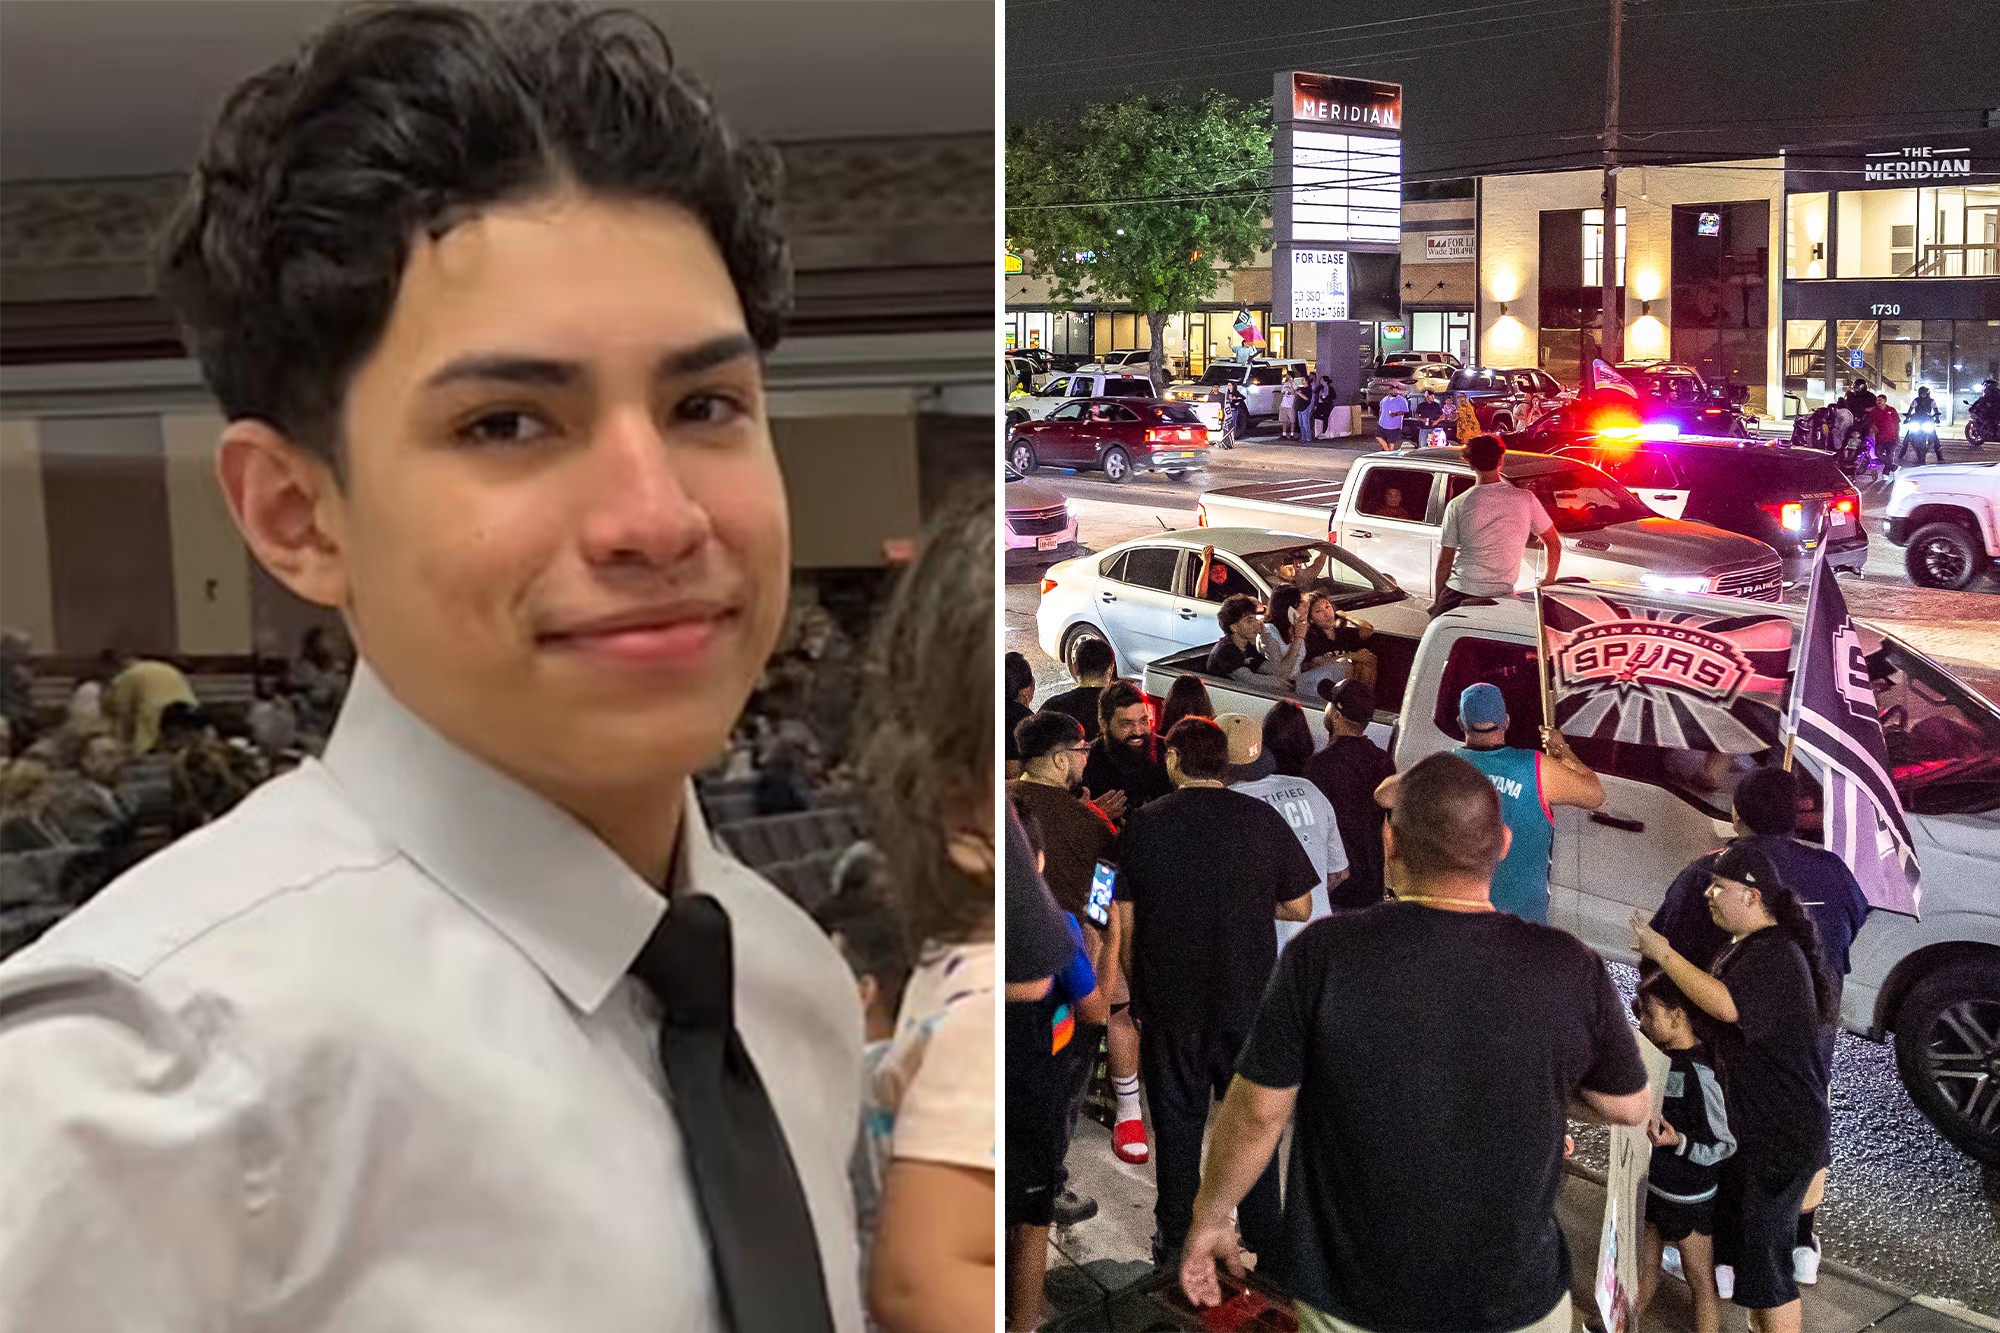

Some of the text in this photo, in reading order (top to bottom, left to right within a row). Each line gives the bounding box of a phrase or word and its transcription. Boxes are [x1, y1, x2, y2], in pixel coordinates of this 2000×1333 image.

[1302, 99, 1393, 125] MERIDIAN
[1903, 146, 1932, 157] THE
[1865, 159, 1970, 181] MERIDIAN
[1447, 238, 1464, 247] FOR
[1295, 253, 1344, 265] FOR LEASE
[1870, 304, 1900, 316] 1730
[1743, 583, 1771, 594] RAM
[1584, 626, 1726, 652] SAN ANTONIO
[1575, 642, 1727, 687] SPURS
